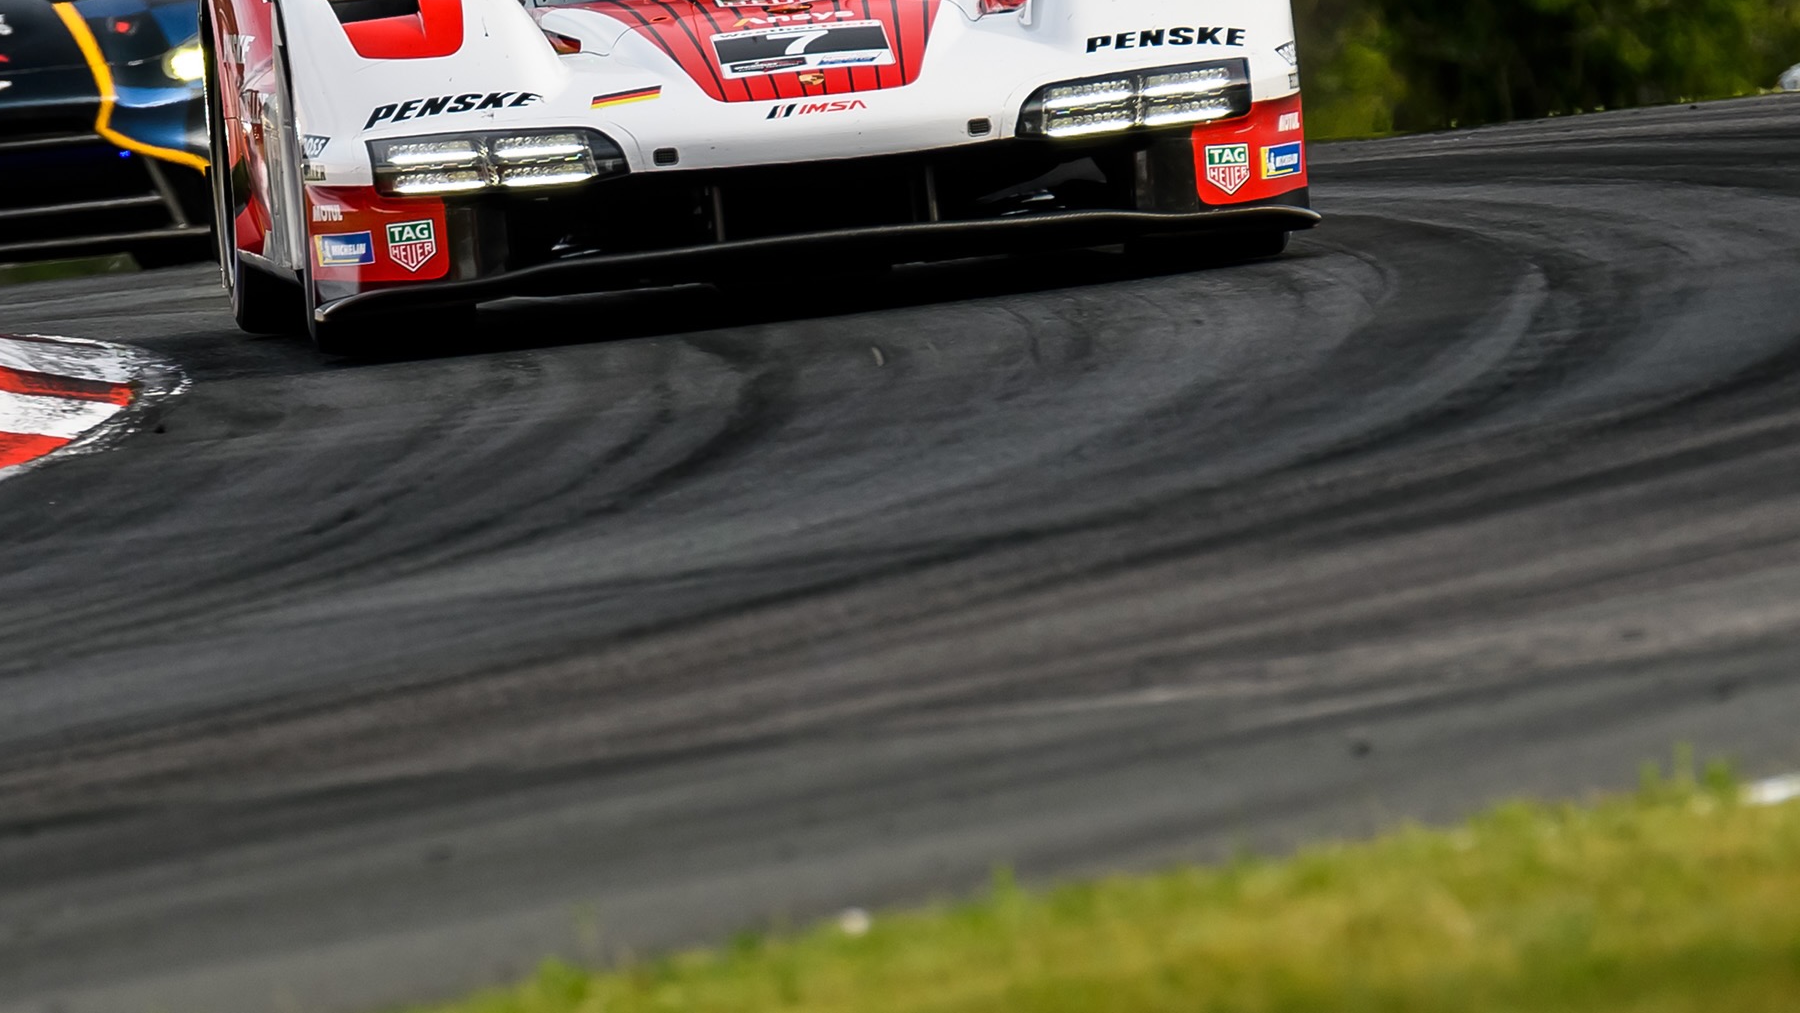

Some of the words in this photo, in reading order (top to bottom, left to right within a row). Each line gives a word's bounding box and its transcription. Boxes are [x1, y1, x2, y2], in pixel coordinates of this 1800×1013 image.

[733, 10, 855, 28] Ansys
[766, 29, 829, 55] 7
[1086, 27, 1247, 53] PENSKE
[363, 91, 543, 131] PENSKE
[798, 99, 868, 116] IMSA
[1209, 147, 1245, 163] TAG
[1210, 166, 1248, 191] HEUER
[312, 204, 344, 222] MOTUL
[390, 224, 429, 241] TAG
[331, 243, 367, 256] MICHELIN
[391, 242, 433, 267] HEUER
